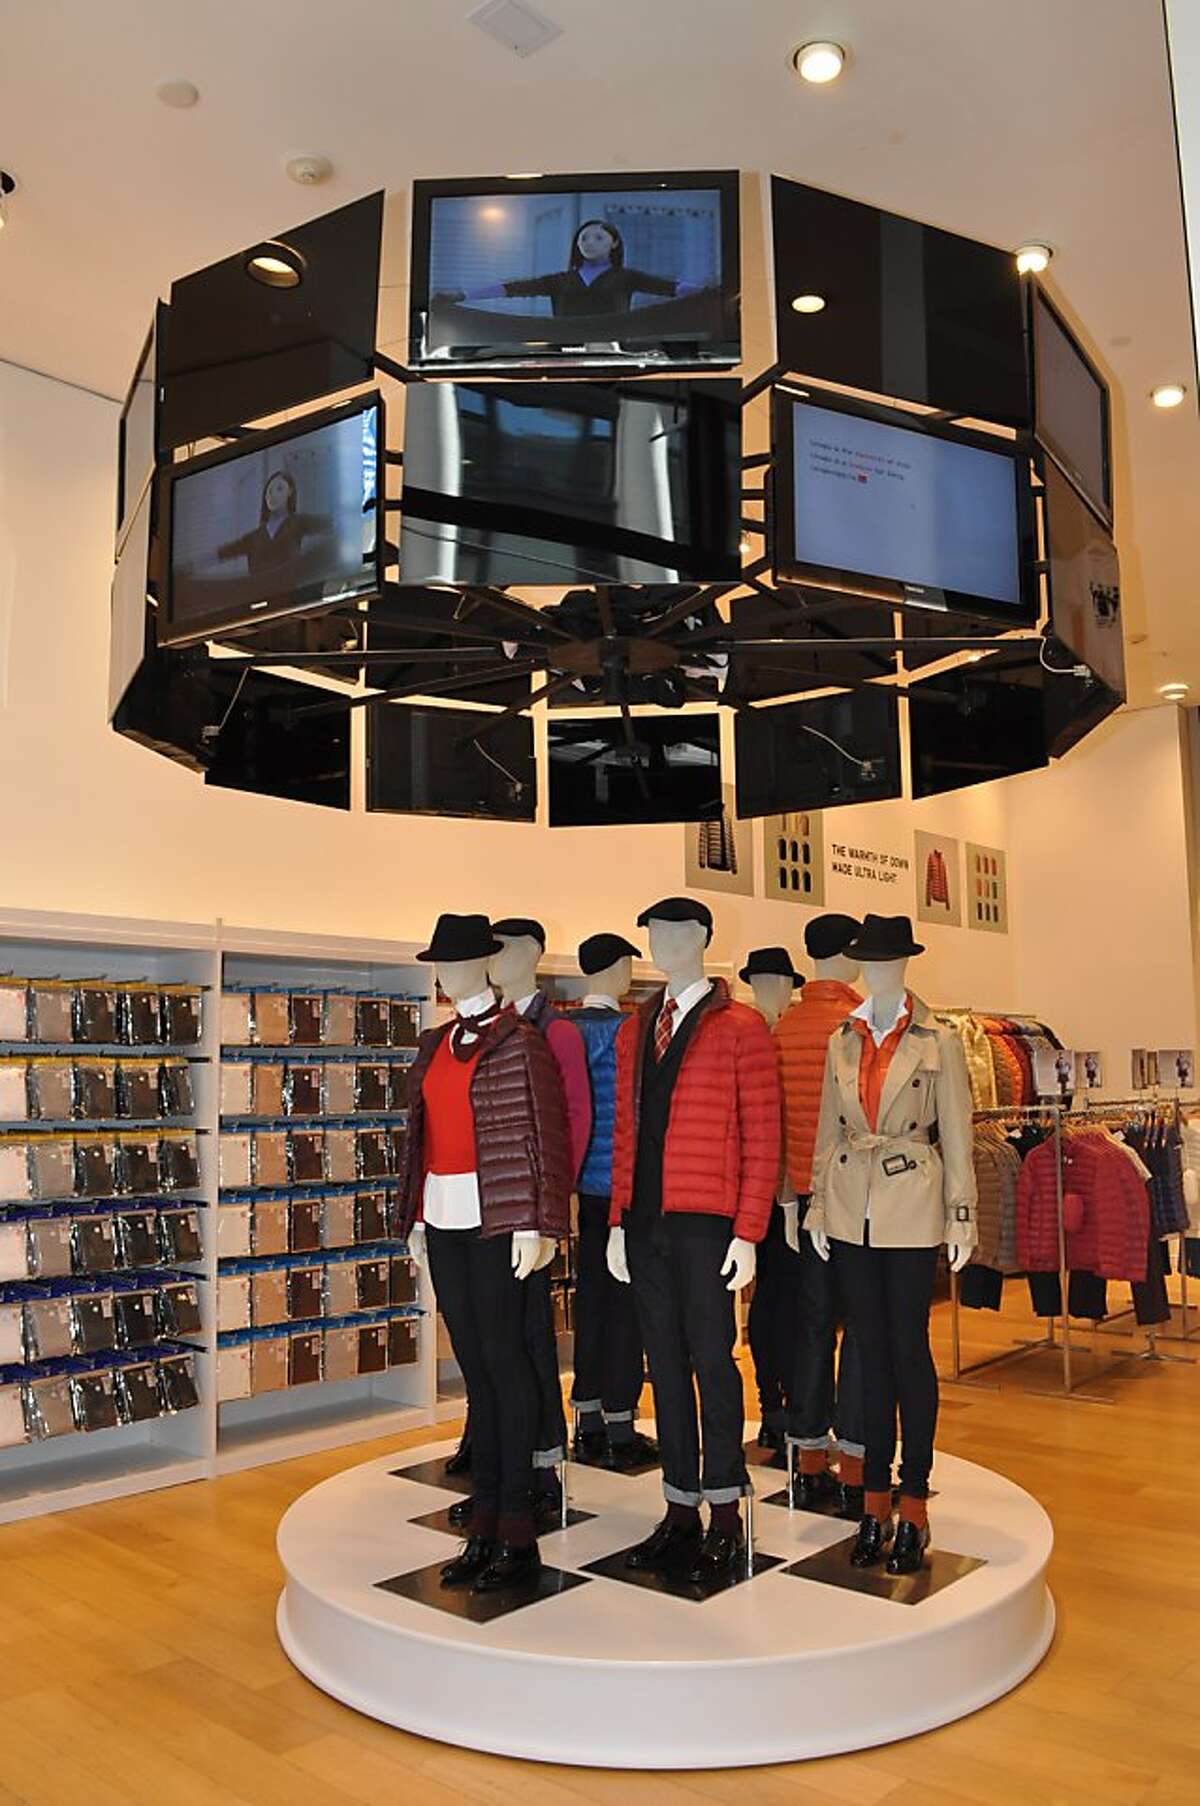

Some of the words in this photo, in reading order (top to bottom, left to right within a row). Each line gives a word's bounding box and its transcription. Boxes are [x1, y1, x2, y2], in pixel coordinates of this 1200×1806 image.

[832, 844, 846, 857] THE
[848, 847, 878, 862] WARMTH
[880, 854, 888, 864] OF
[890, 856, 909, 870] DOWN
[832, 861, 853, 876] MADE
[855, 866, 877, 880] ULTRA
